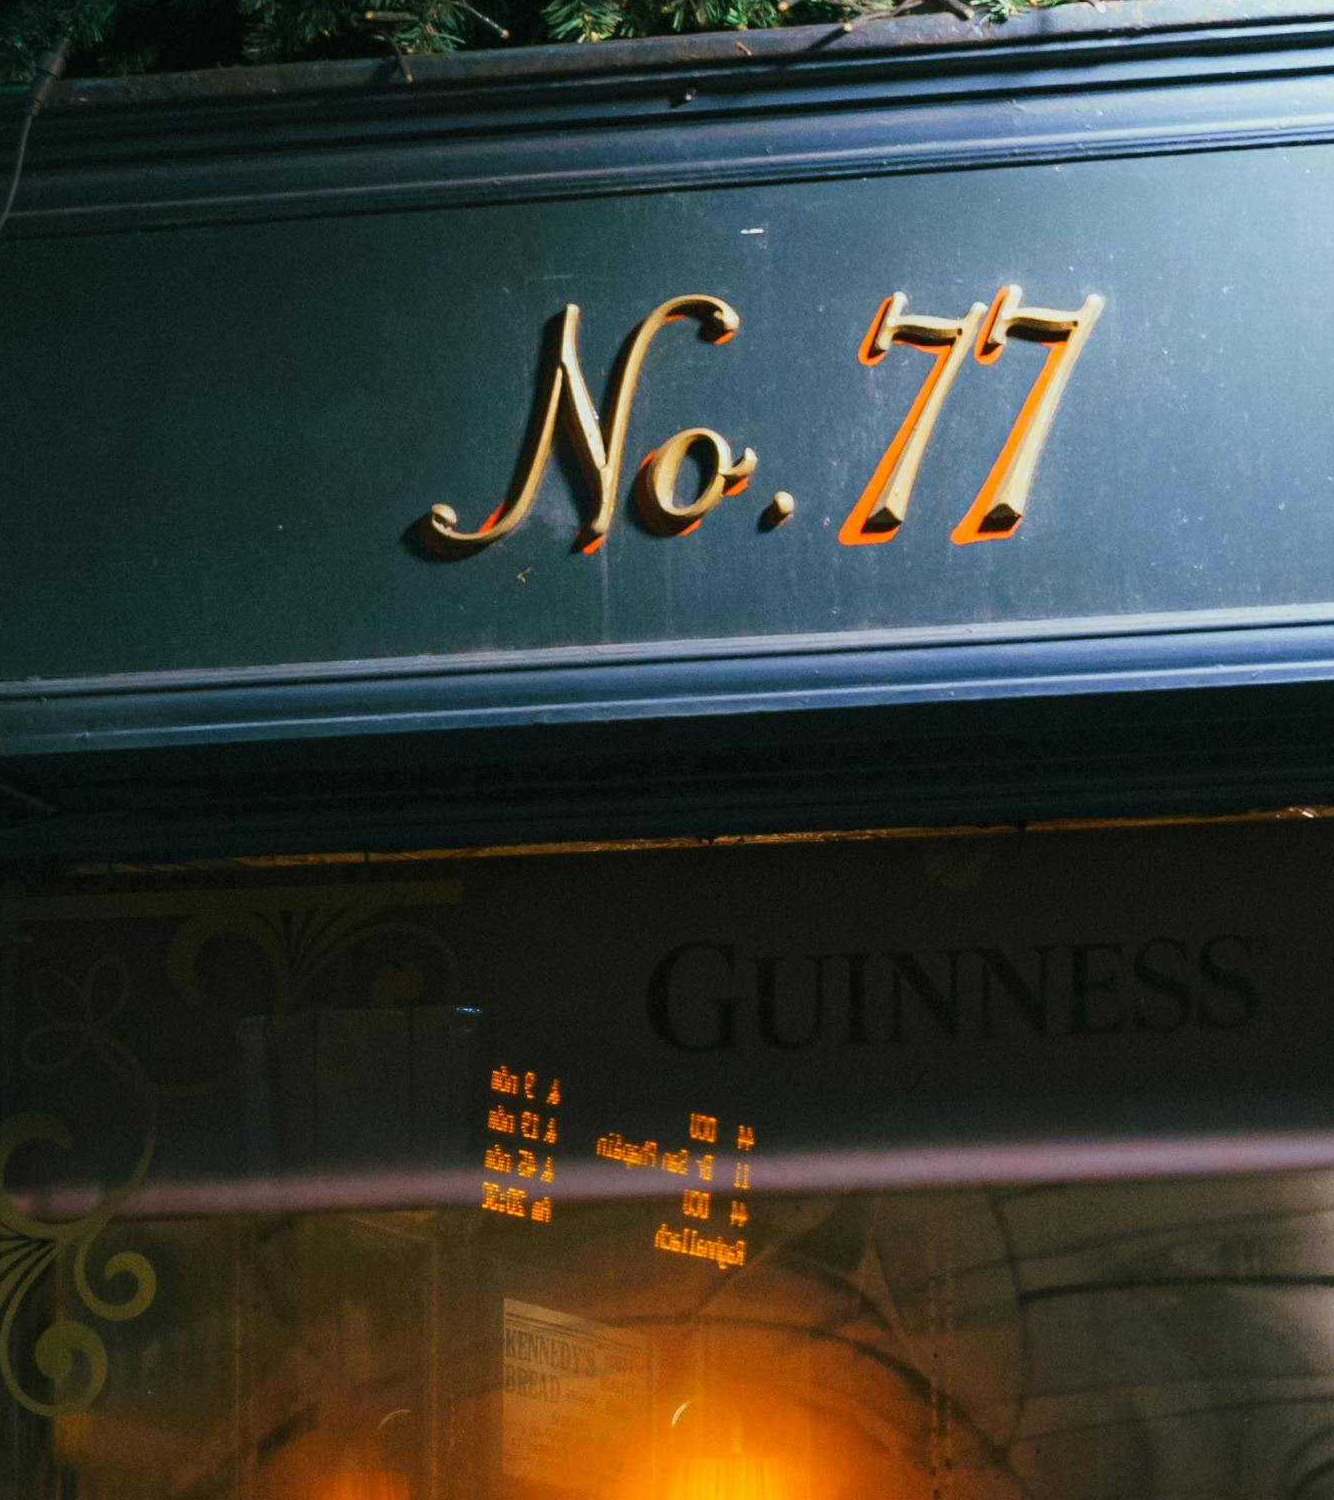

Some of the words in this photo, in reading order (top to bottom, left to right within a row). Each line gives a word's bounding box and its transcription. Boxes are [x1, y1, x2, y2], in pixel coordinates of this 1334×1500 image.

[427, 293, 795, 555] No.
[837, 284, 1104, 546] 77
[646, 931, 1261, 1054] GUINNESS
[504, 1363, 562, 1405] BREAD
